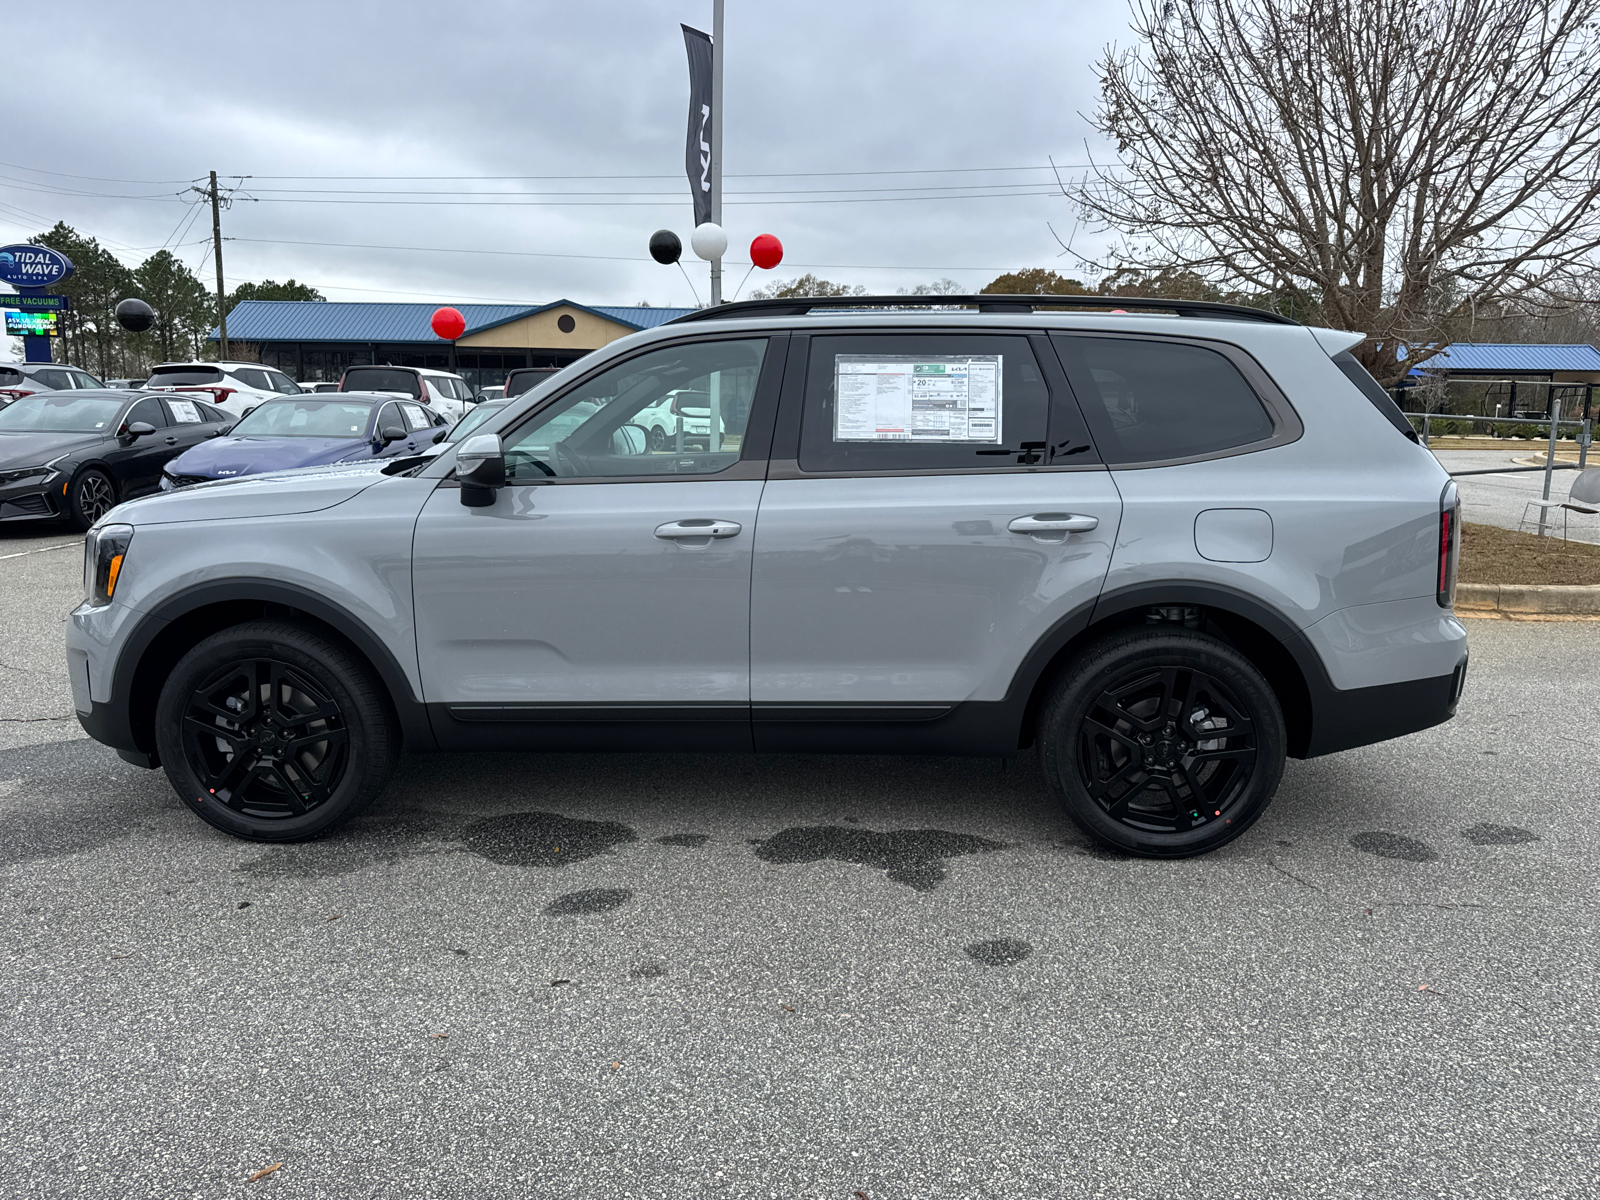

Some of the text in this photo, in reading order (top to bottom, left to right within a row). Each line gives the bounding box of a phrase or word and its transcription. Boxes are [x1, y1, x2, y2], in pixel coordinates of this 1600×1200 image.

[14, 252, 52, 264] TIDAL
[22, 264, 60, 275] WAVE
[22, 298, 59, 306] VACUUMS
